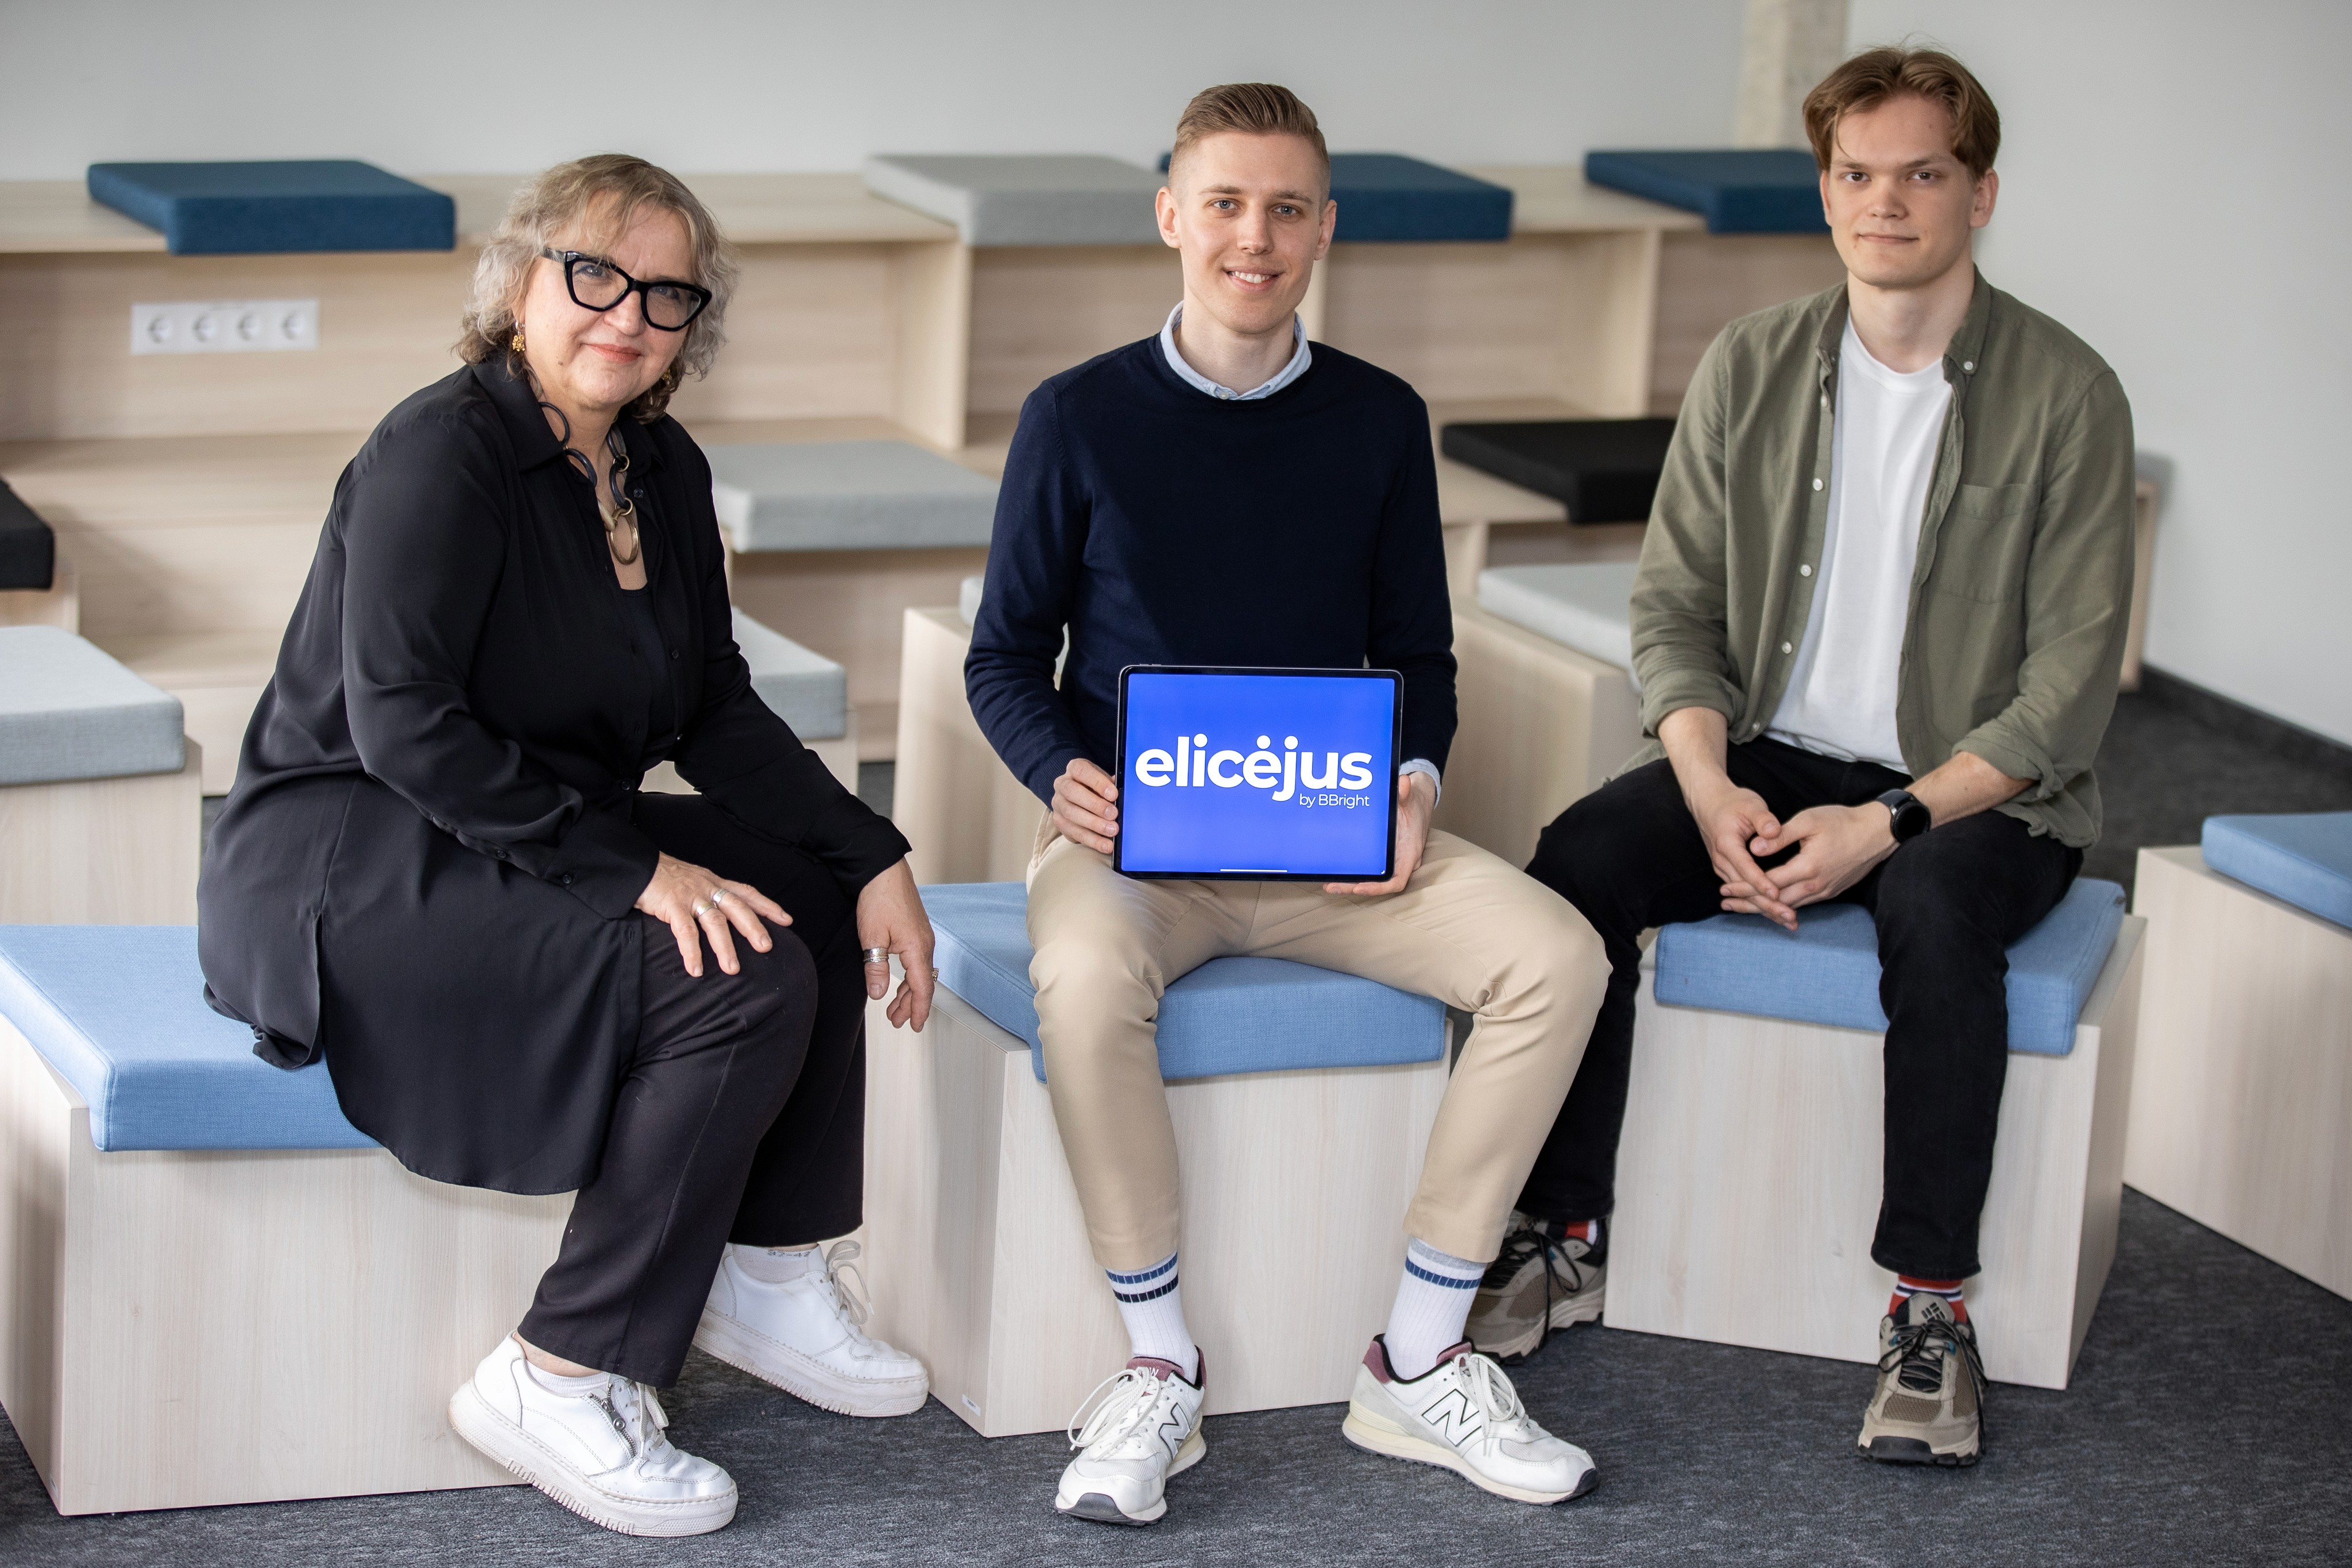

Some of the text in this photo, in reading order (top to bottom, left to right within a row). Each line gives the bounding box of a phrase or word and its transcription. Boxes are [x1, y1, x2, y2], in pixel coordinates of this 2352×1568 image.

[1135, 733, 1373, 802] elicėjus
[1299, 793, 1370, 809] by BBright
[1421, 1388, 1482, 1447] N
